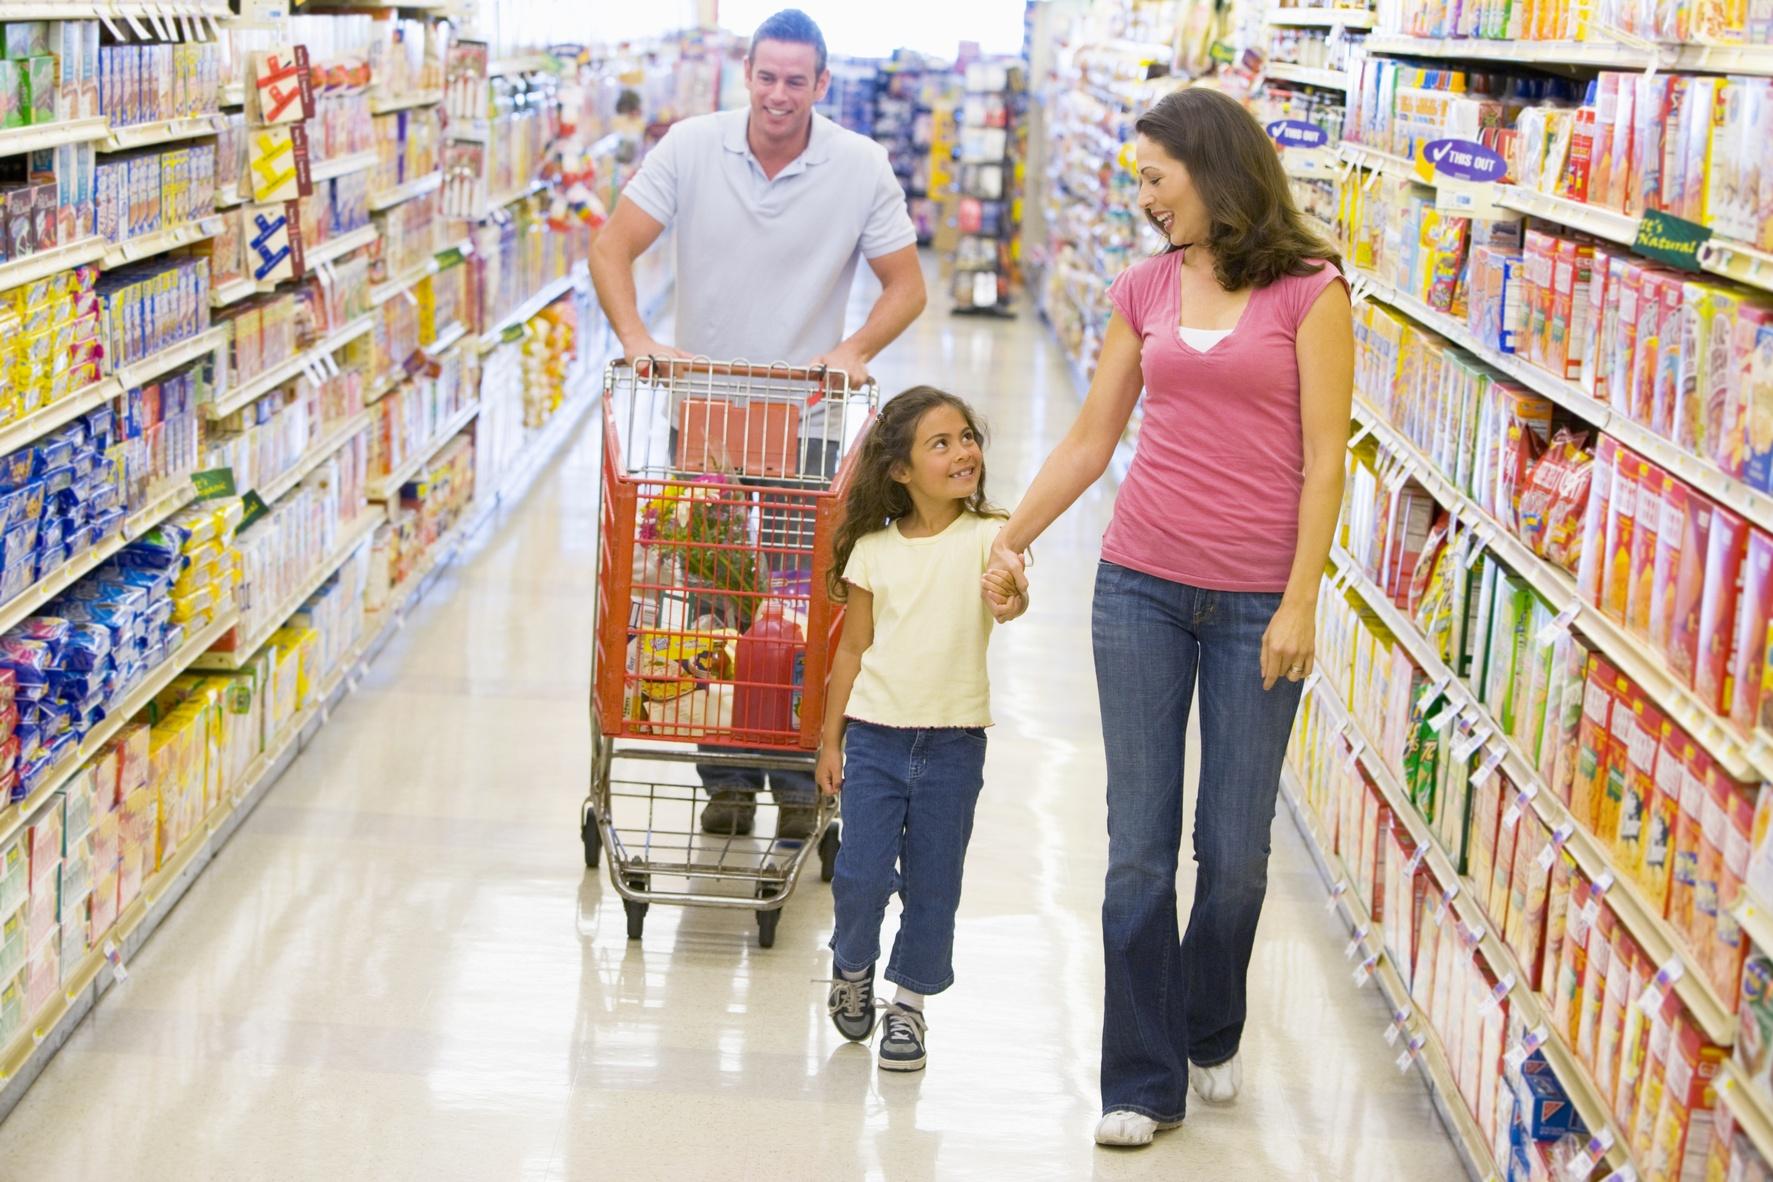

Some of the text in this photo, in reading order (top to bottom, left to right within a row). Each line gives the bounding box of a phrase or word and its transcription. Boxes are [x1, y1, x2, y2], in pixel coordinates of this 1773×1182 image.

[1448, 150, 1496, 172] THIS OUT
[1640, 218, 1663, 234] It's
[1637, 233, 1697, 254] Natural
